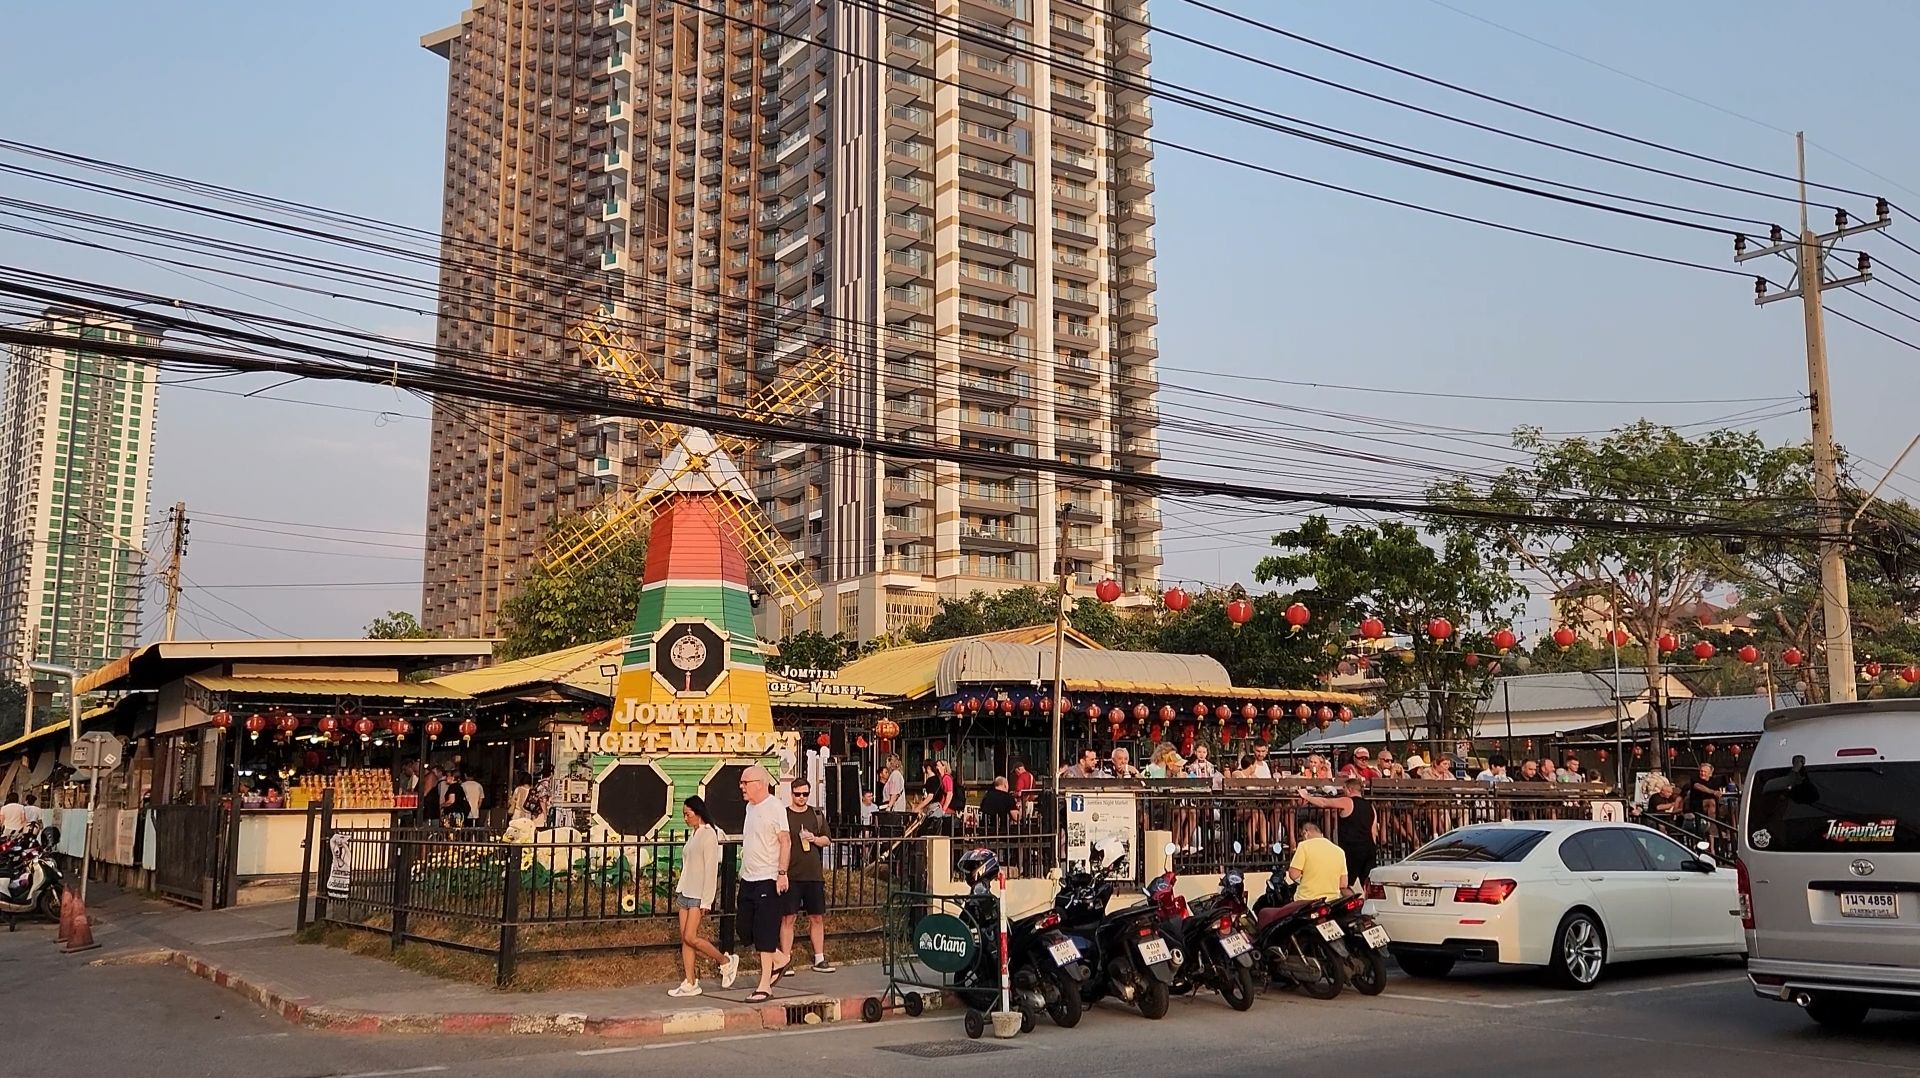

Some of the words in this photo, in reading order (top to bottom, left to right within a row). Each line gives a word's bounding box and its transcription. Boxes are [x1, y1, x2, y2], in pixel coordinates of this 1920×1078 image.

[781, 665, 838, 679] JOMTIEN
[768, 682, 797, 692] IGHT
[810, 681, 865, 695] MARKET
[615, 697, 750, 724] JOMTIEN
[562, 725, 660, 752] NIGHT
[1867, 895, 1893, 906] 4858
[933, 933, 966, 957] Chang
